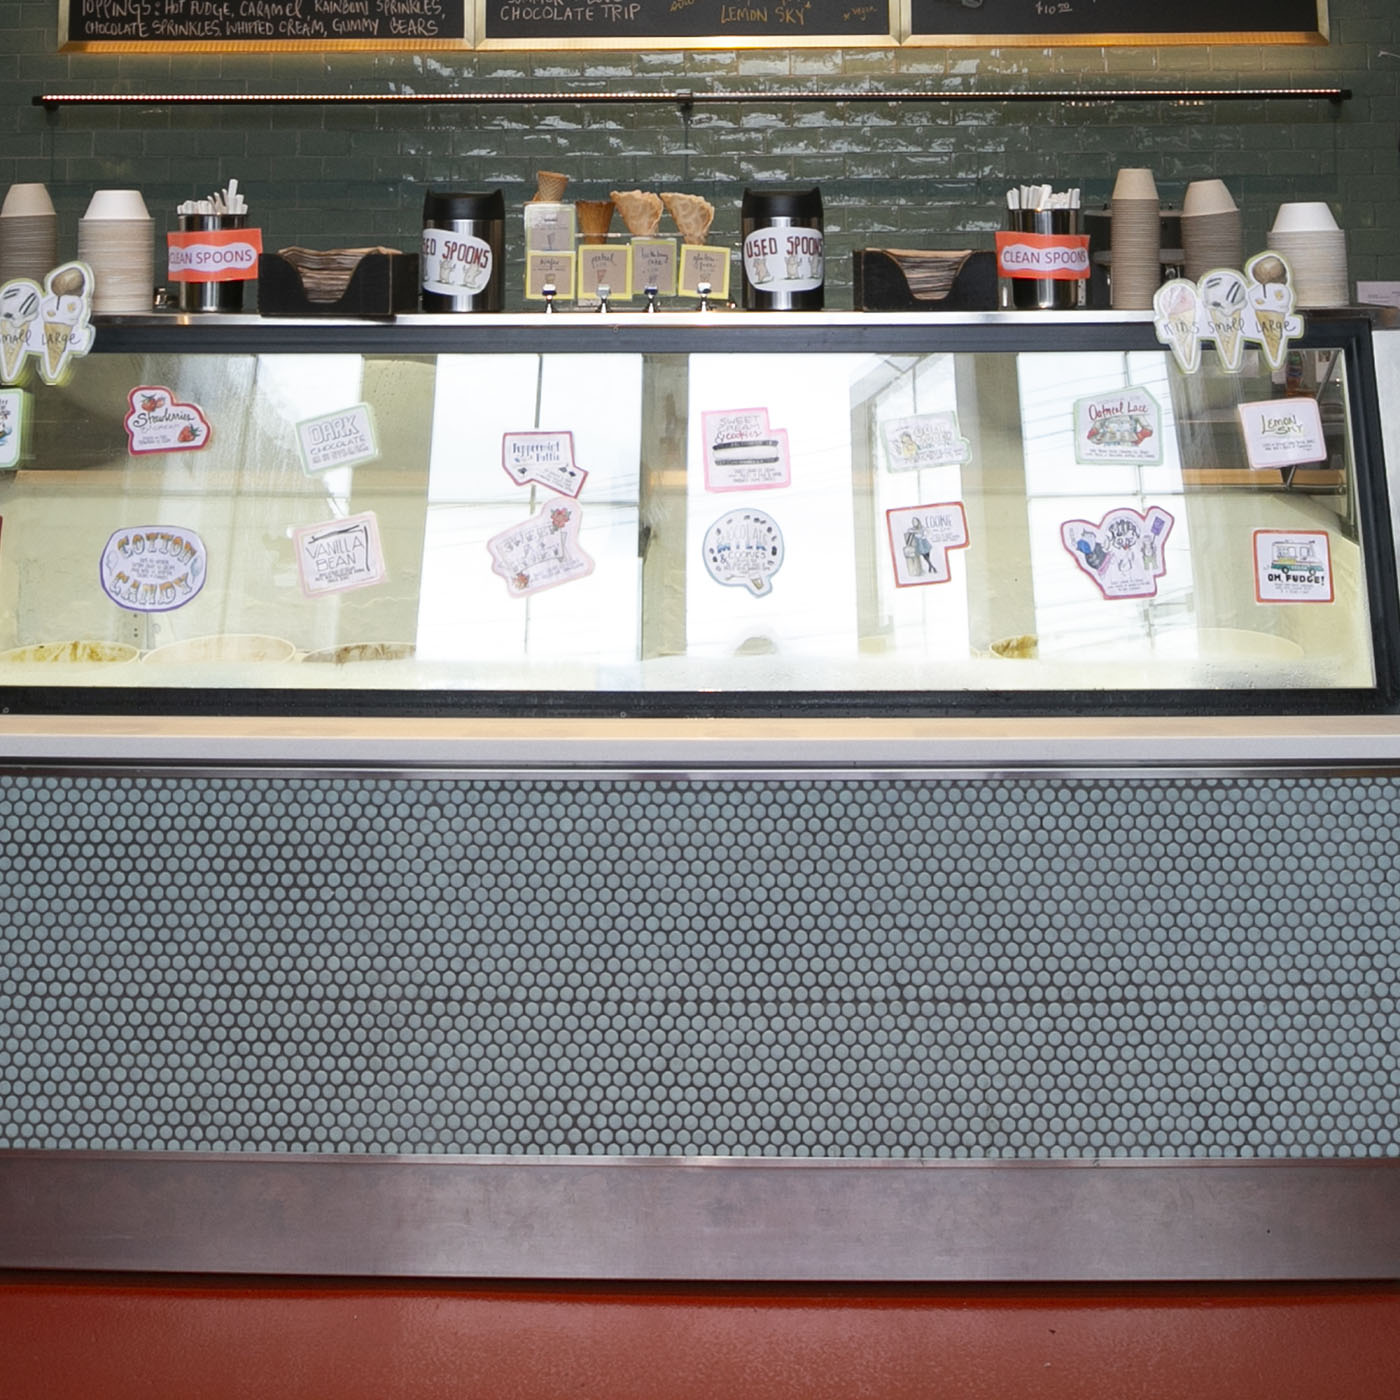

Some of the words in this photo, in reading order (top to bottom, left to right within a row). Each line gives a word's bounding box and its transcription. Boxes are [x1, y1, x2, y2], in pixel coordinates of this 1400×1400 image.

[165, 0, 185, 16] HOT
[500, 5, 594, 22] CHOCOLATE
[601, 3, 641, 22] TRIP
[721, 5, 768, 24] LEMON
[85, 21, 149, 38] CHOCOLATE
[332, 18, 379, 35] GUMMY
[390, 18, 439, 36] BEARS
[423, 238, 436, 255] ED
[442, 241, 490, 269] SPOONS
[746, 237, 778, 258] USED
[786, 236, 823, 257] SPOONS
[169, 252, 192, 264] CLEAN
[195, 250, 252, 264] SPOONS
[1003, 250, 1040, 264] CLEAN
[1044, 250, 1086, 264] SPOONS
[133, 408, 194, 427] Strawberries
[719, 415, 760, 425] SWEET
[1089, 402, 1124, 421] Oatmeal
[1128, 401, 1149, 413] Lace
[309, 415, 360, 445] DARK
[1261, 415, 1296, 434] LEMON
[310, 435, 366, 455] CHOCOLATE
[118, 532, 197, 565] COTTON
[306, 536, 364, 560] VANILLA
[316, 554, 356, 572] BEAN
[109, 571, 193, 605] CANDY
[1286, 574, 1325, 586] FUDGE!
